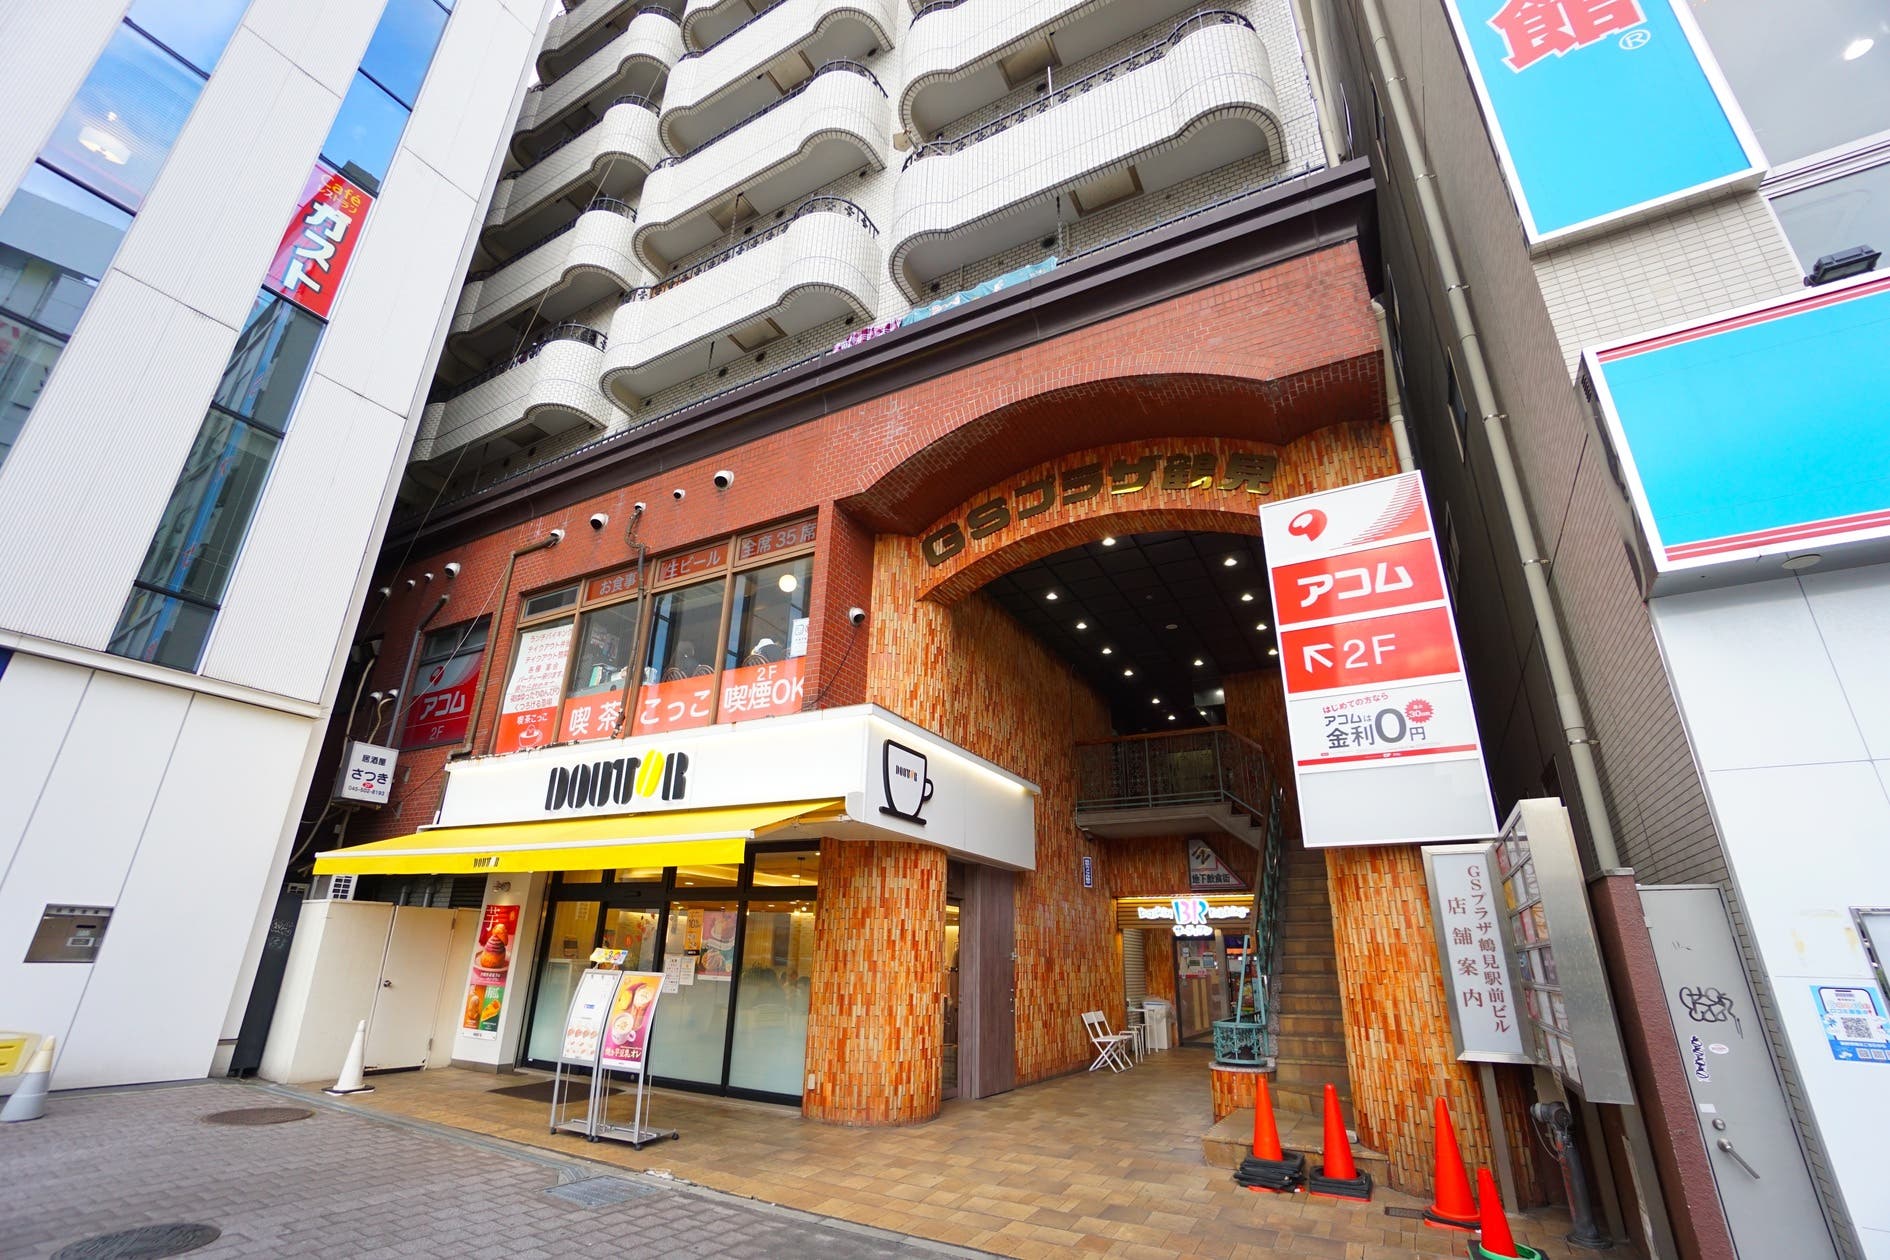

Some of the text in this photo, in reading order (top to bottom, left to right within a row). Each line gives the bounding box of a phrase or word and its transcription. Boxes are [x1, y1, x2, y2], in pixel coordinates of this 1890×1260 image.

[321, 174, 362, 207] Café
[282, 201, 353, 293] ガスト
[921, 454, 1277, 567] GSプラザ鶴見
[664, 550, 721, 579] 生ビール
[599, 571, 637, 595] お食事
[1297, 562, 1414, 607] アコム
[1343, 633, 1396, 670] 2F
[757, 667, 777, 682] 2F
[420, 690, 466, 721] アコム
[639, 689, 711, 725] こっこ
[724, 676, 804, 712] 喫煙OK
[1322, 692, 1389, 714] はじめての方なら
[429, 725, 445, 740] 2F
[1324, 713, 1373, 727] アコムは
[361, 754, 387, 767] 居酒屋
[351, 768, 389, 785] さつき
[544, 749, 690, 811] DOUTOR
[473, 856, 500, 868] DOUTOR
[1192, 873, 1231, 884] 地下飲食街
[483, 906, 500, 932] 芋
[1172, 899, 1208, 924] BR
[1447, 897, 1484, 1008] 店舗案内
[1467, 865, 1510, 1033] GSプラザ鶴見駅前ビル
